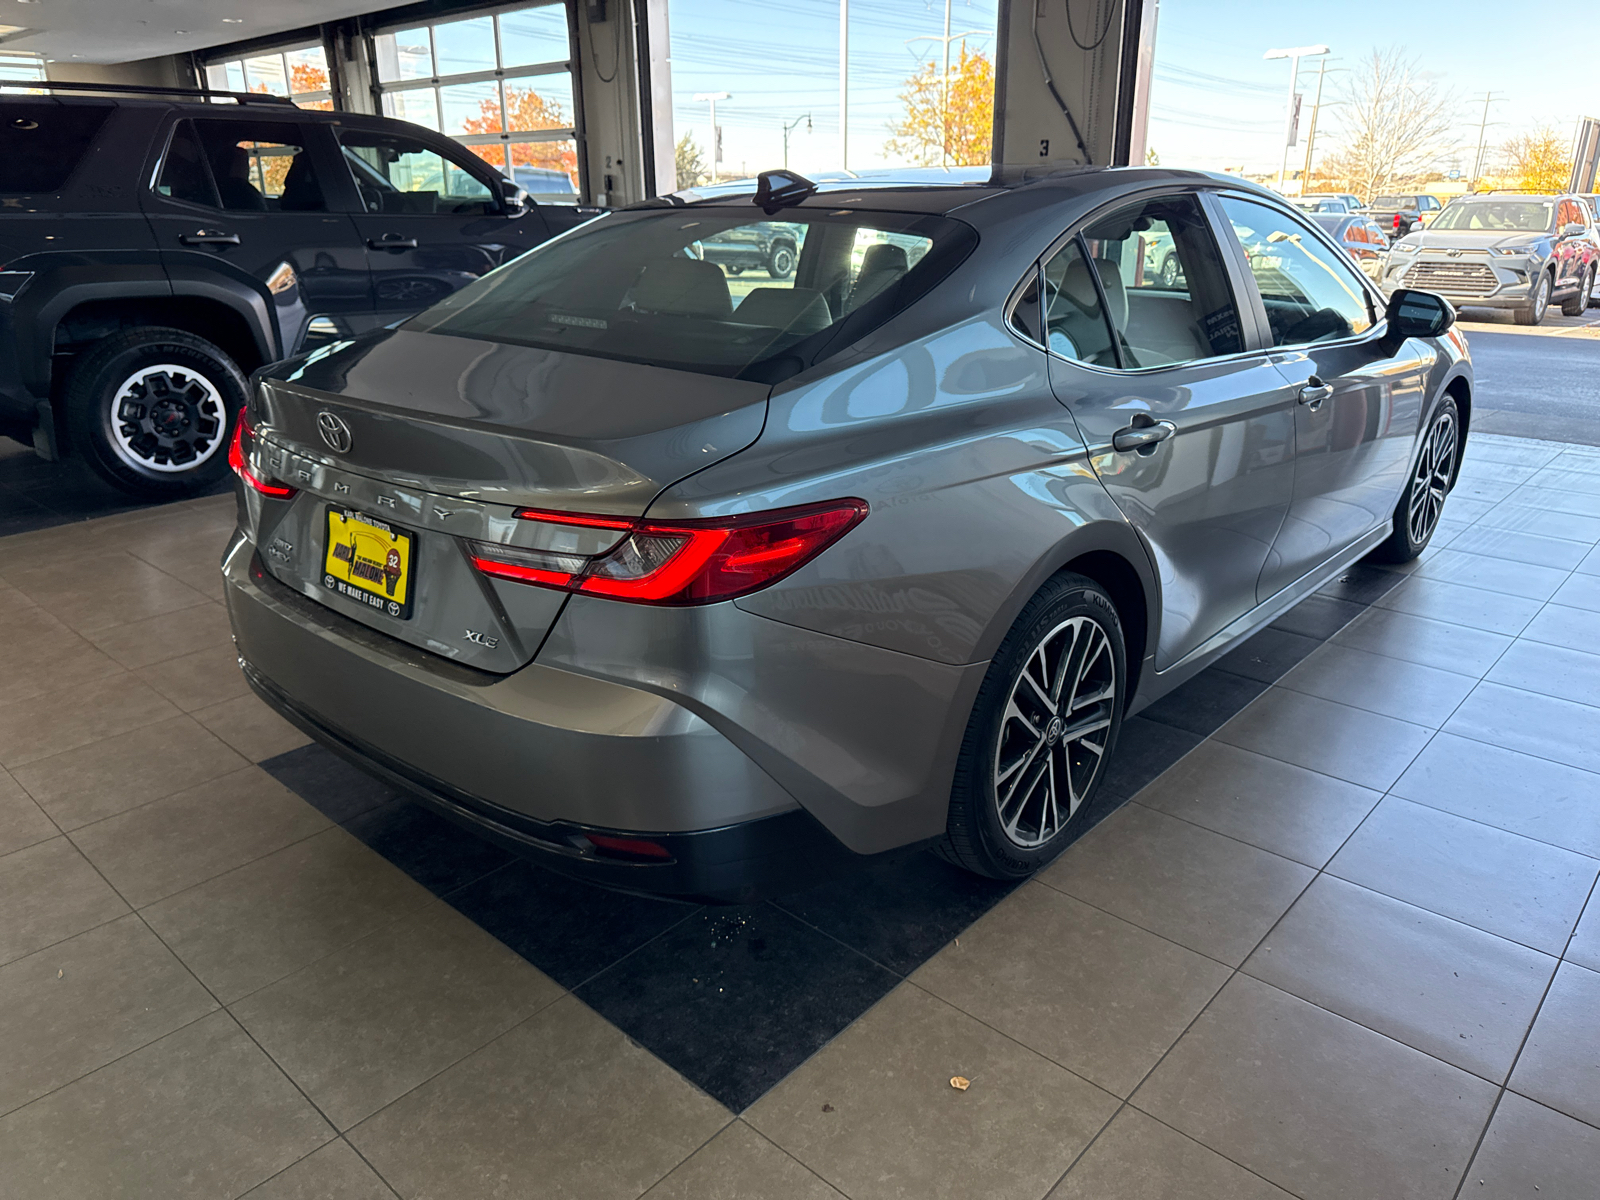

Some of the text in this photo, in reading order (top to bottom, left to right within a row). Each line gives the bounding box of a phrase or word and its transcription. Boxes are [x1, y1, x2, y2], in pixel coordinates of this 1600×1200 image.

[1039, 139, 1049, 157] 3
[605, 156, 611, 168] 2
[163, 345, 225, 372] MICHELIN
[269, 457, 455, 520] CAMRY
[353, 561, 384, 585] MALONE
[388, 554, 398, 568] 32
[338, 582, 384, 609] WE MAKE IT EASY
[1092, 593, 1119, 627] KUMHO
[464, 629, 500, 649] XLE
[1008, 615, 1048, 676] SOLUS
[996, 848, 1030, 869] KUMHO
